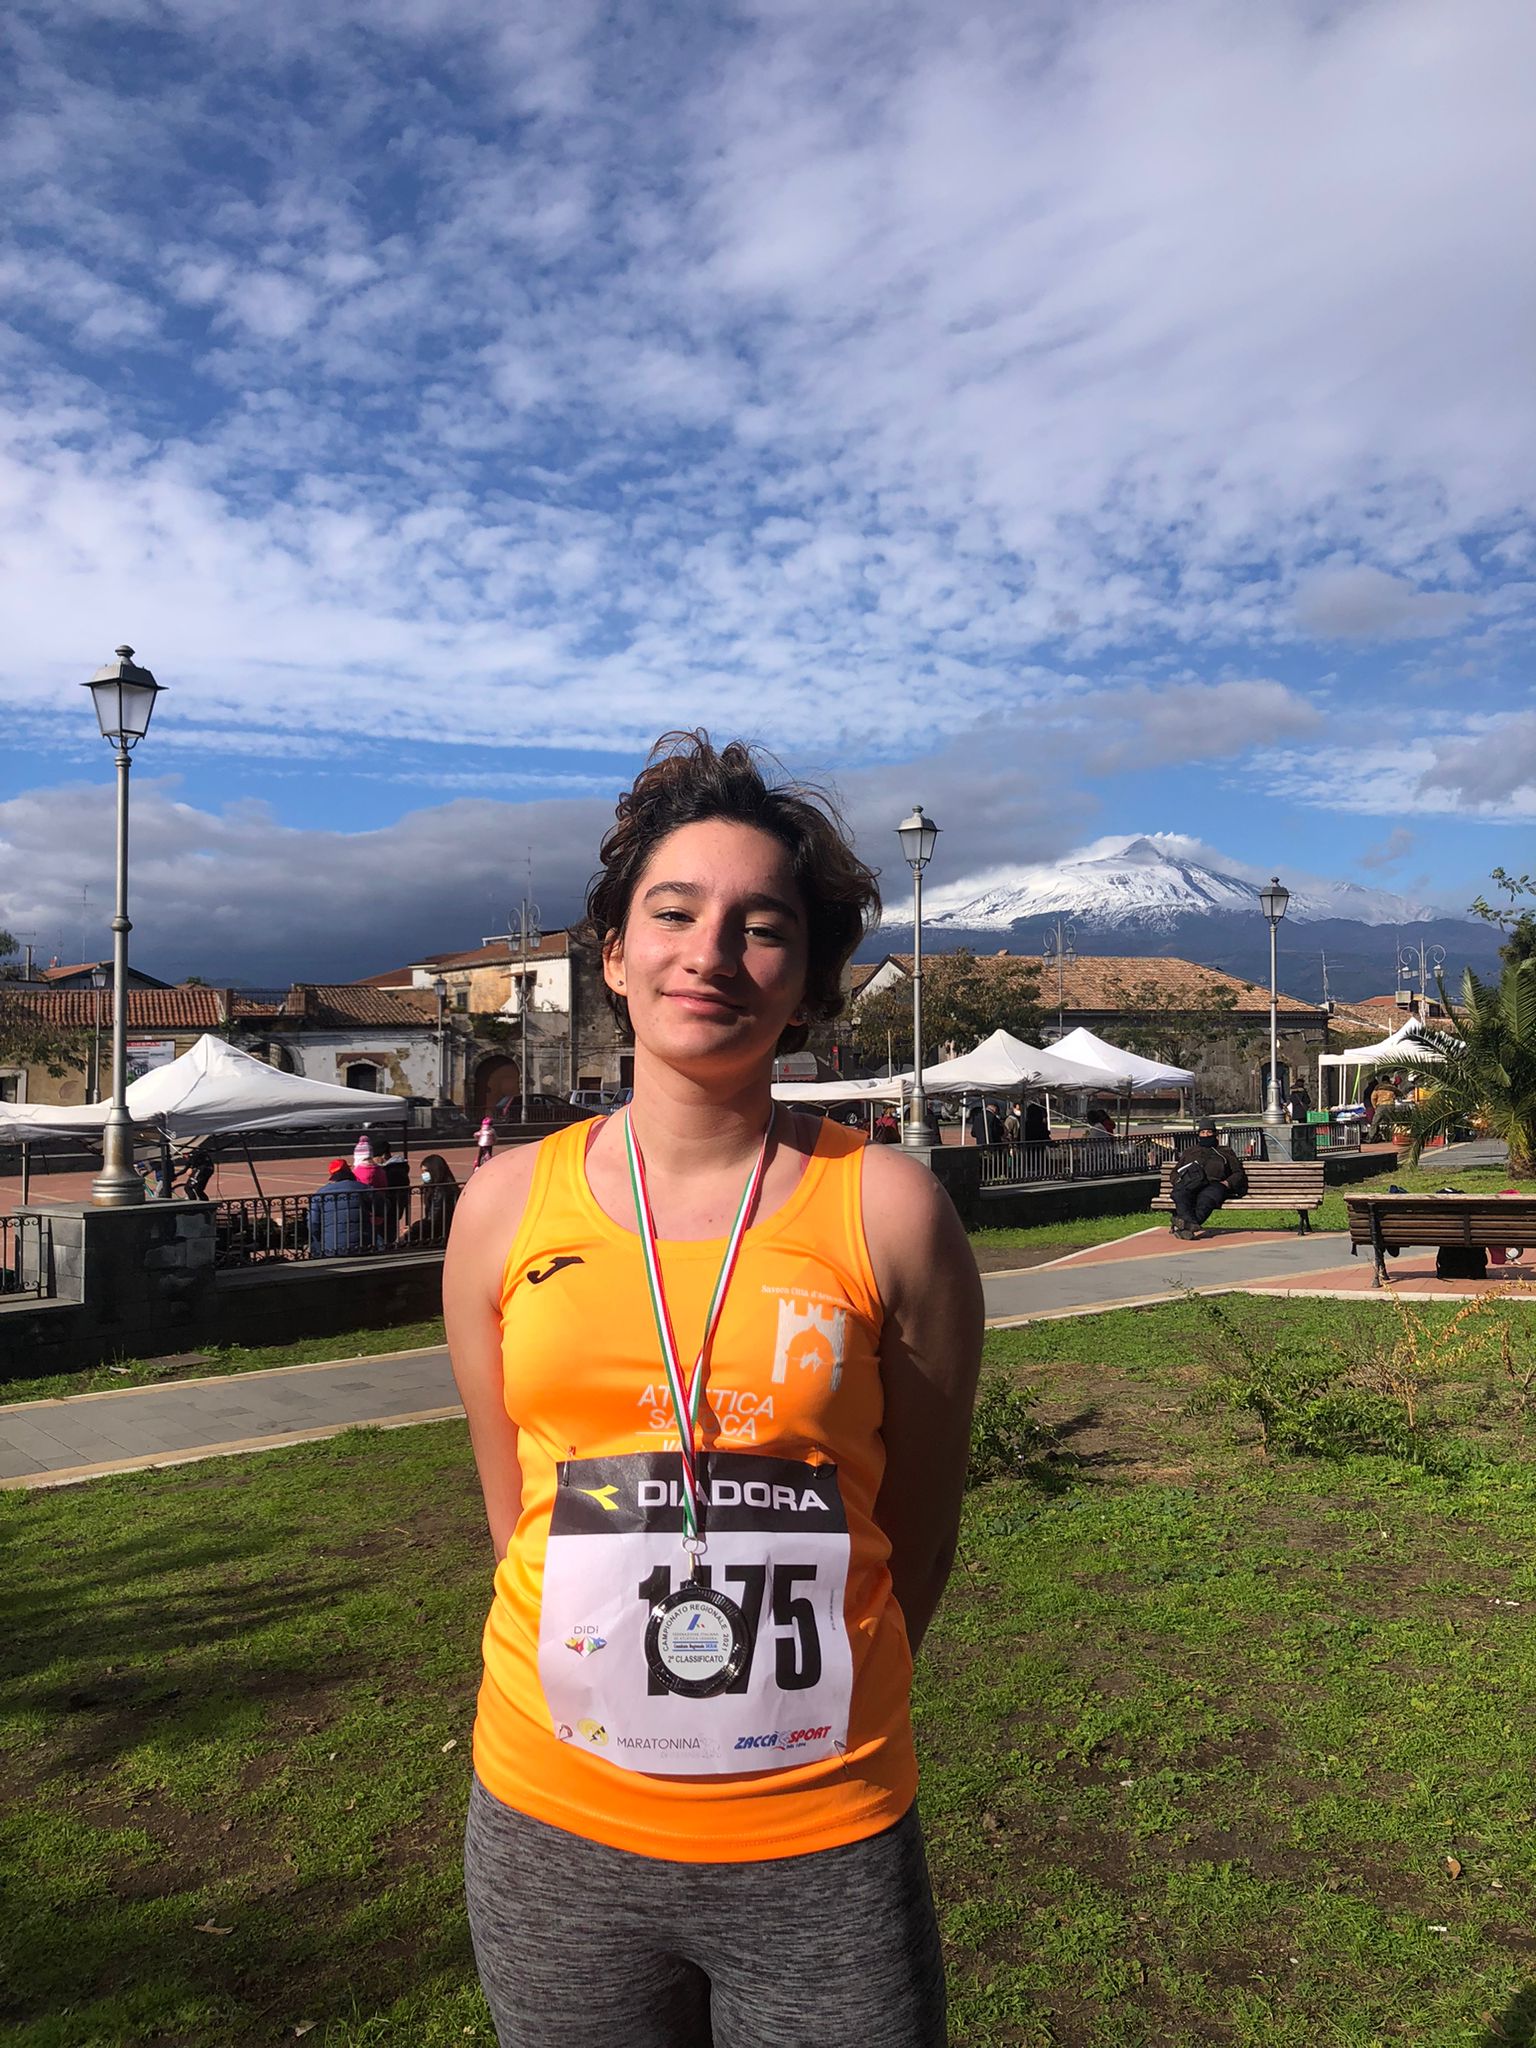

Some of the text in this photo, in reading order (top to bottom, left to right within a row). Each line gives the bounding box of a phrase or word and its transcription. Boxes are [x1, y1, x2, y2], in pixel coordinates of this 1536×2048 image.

[637, 1384, 774, 1420] ATTICA
[648, 1408, 756, 1440] SAOCA
[638, 1564, 822, 1696] 175
[662, 1606, 688, 1652] CAMPIONATO
[689, 1604, 728, 1630] REGIONALE
[675, 1655, 724, 1663] CLASSIFICATO
[617, 1736, 700, 1750] MARATONINA
[788, 1725, 832, 1744] SPORT
